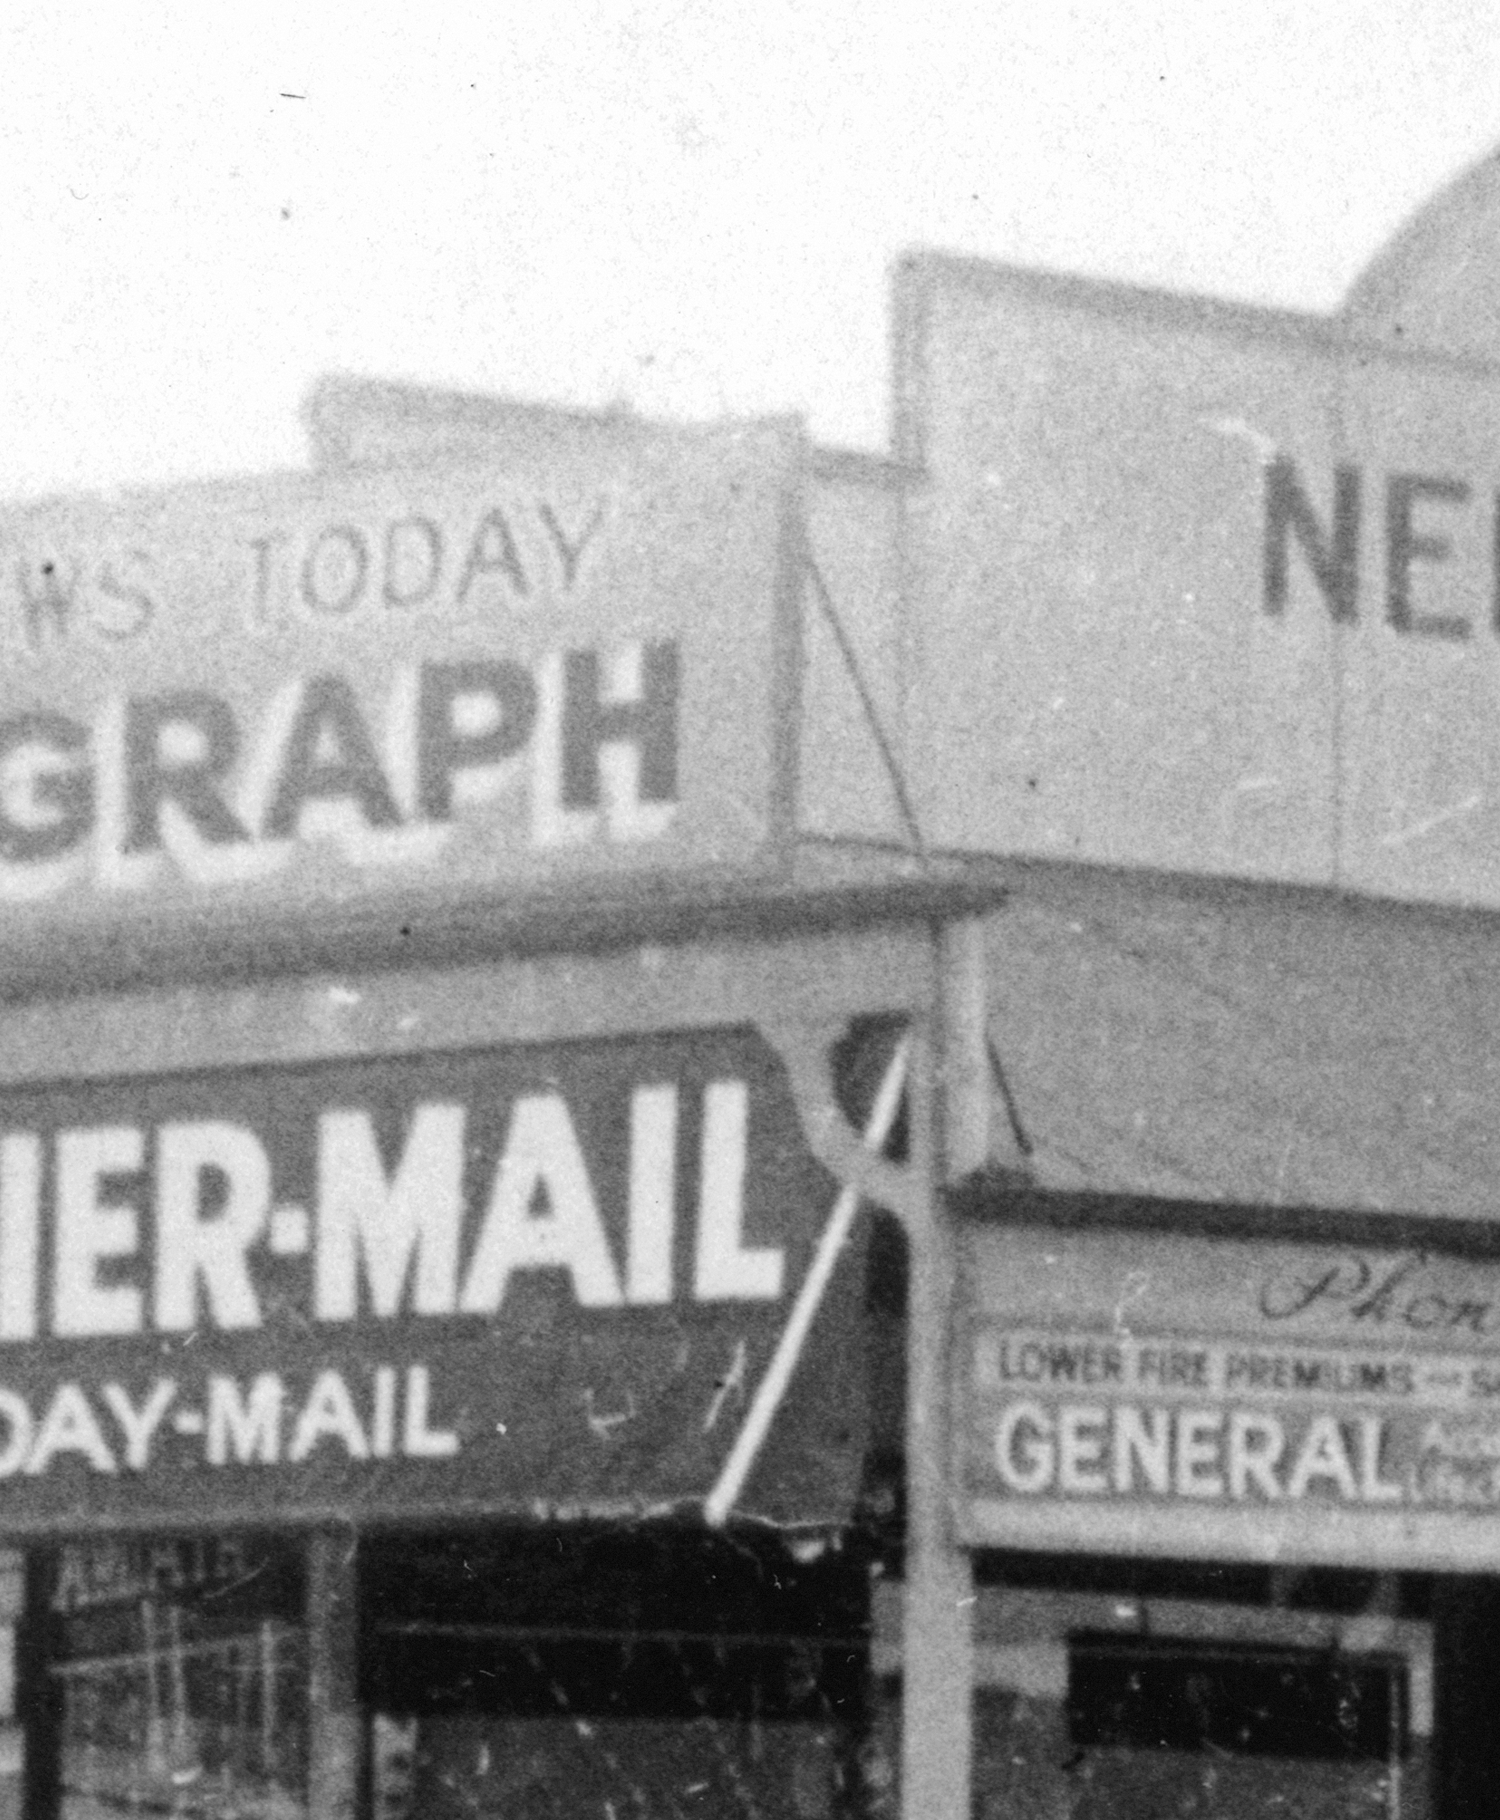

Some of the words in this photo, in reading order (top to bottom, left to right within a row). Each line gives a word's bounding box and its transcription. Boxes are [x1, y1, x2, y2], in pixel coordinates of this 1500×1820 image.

[246, 498, 610, 633] TODAY
[1002, 1342, 1121, 1384] LOWER
[1137, 1347, 1206, 1388] FIRE
[1226, 1348, 1415, 1394] PREMIUMS
[996, 1402, 1402, 1500] GENERAL
